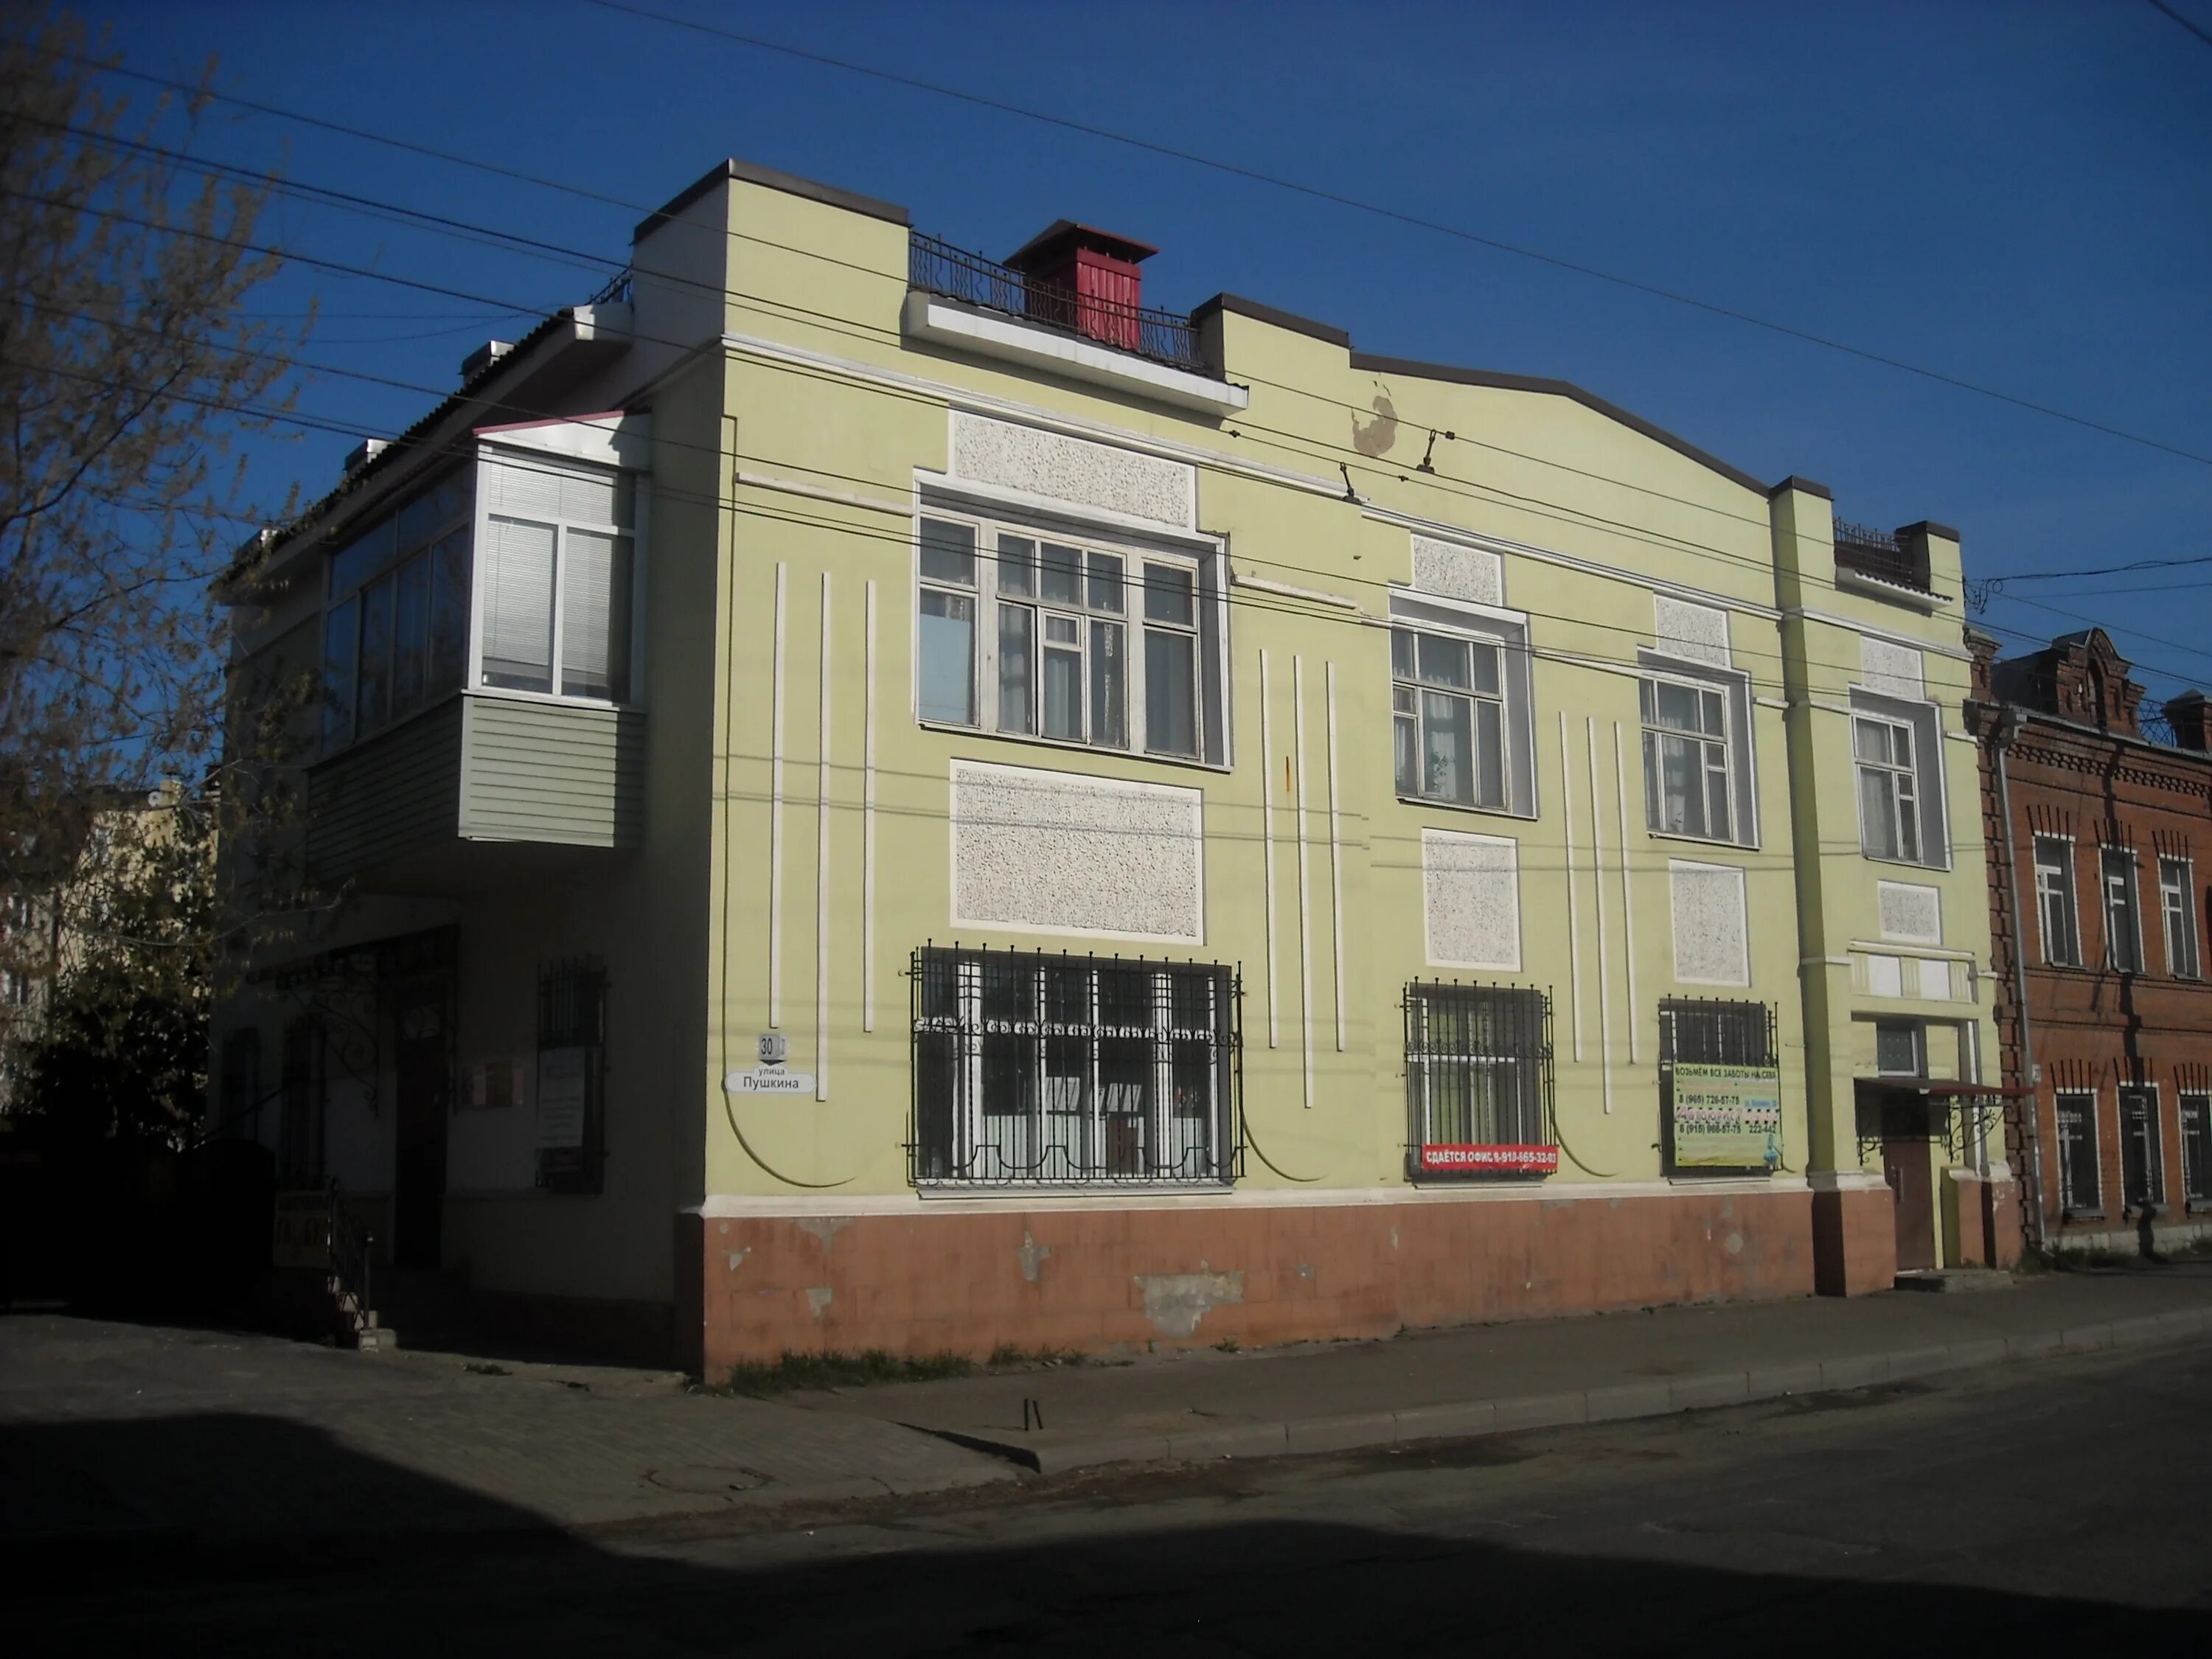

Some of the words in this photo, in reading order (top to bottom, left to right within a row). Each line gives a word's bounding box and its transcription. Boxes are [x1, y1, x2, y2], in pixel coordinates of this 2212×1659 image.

[761, 1038, 773, 1055] 30
[1711, 1068, 1722, 1078] ВСЕ
[1724, 1069, 1749, 1079] ЗАБОТЫ
[1751, 1070, 1761, 1079] НА
[1761, 1071, 1776, 1079] СЕБЯ
[744, 1077, 799, 1091] Пушкина
[1679, 1094, 1684, 1104] 8
[1426, 1149, 1467, 1164] СДАЁТСЯ
[1467, 1151, 1493, 1164] ОФИС
